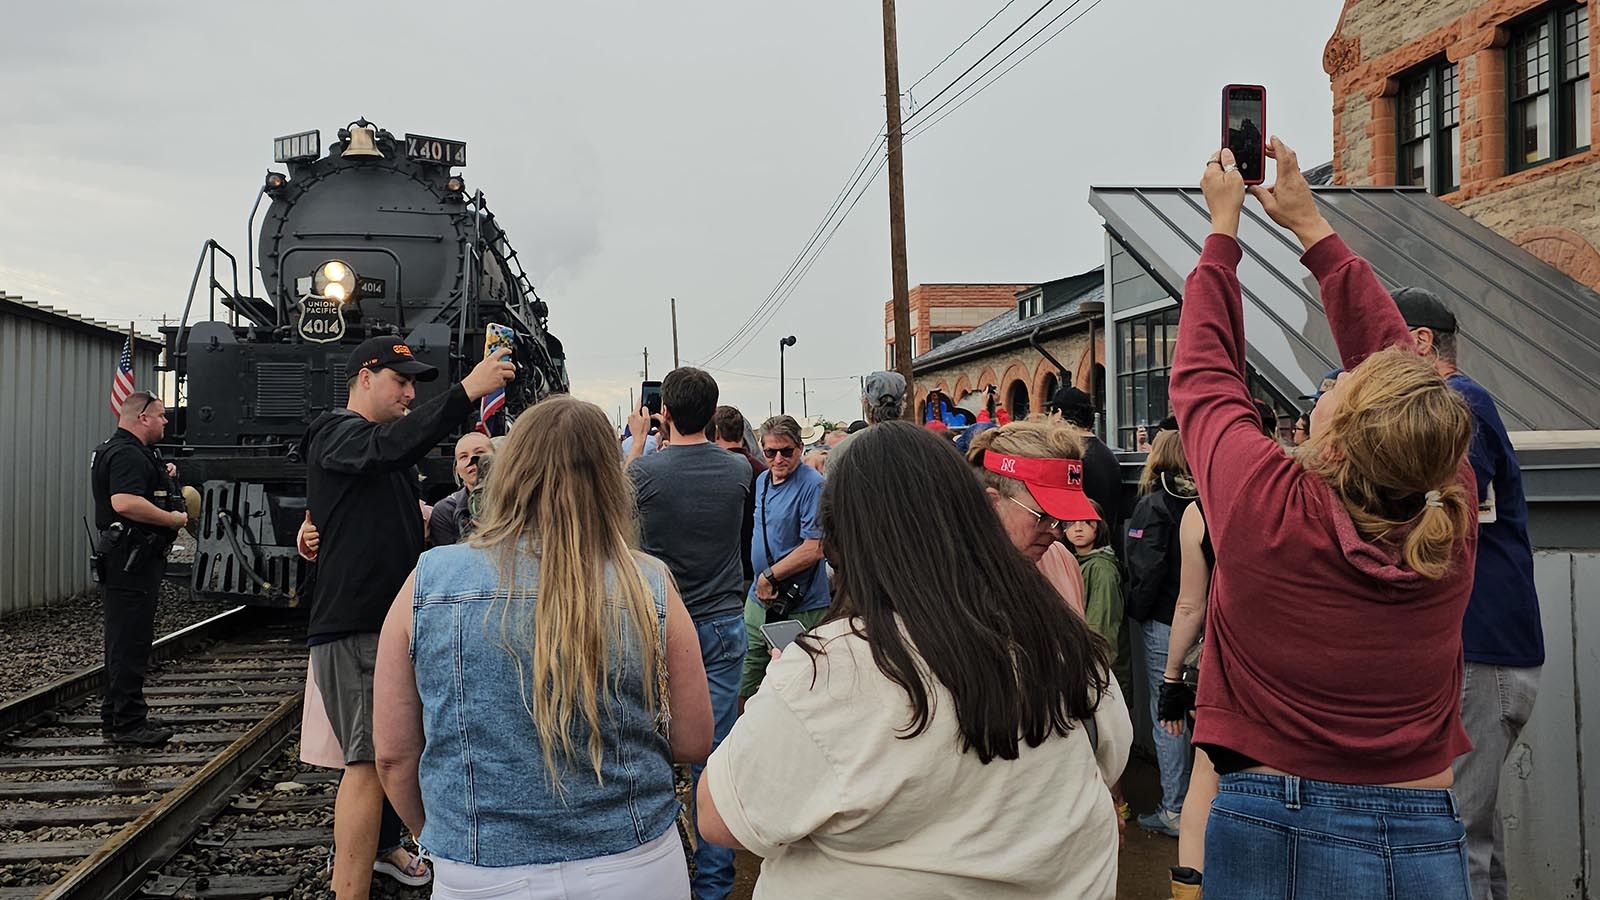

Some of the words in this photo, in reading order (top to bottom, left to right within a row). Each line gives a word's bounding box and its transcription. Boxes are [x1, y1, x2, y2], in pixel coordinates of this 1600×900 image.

[407, 138, 465, 163] X4014
[361, 282, 382, 293] 4014
[302, 319, 340, 334] 4014
